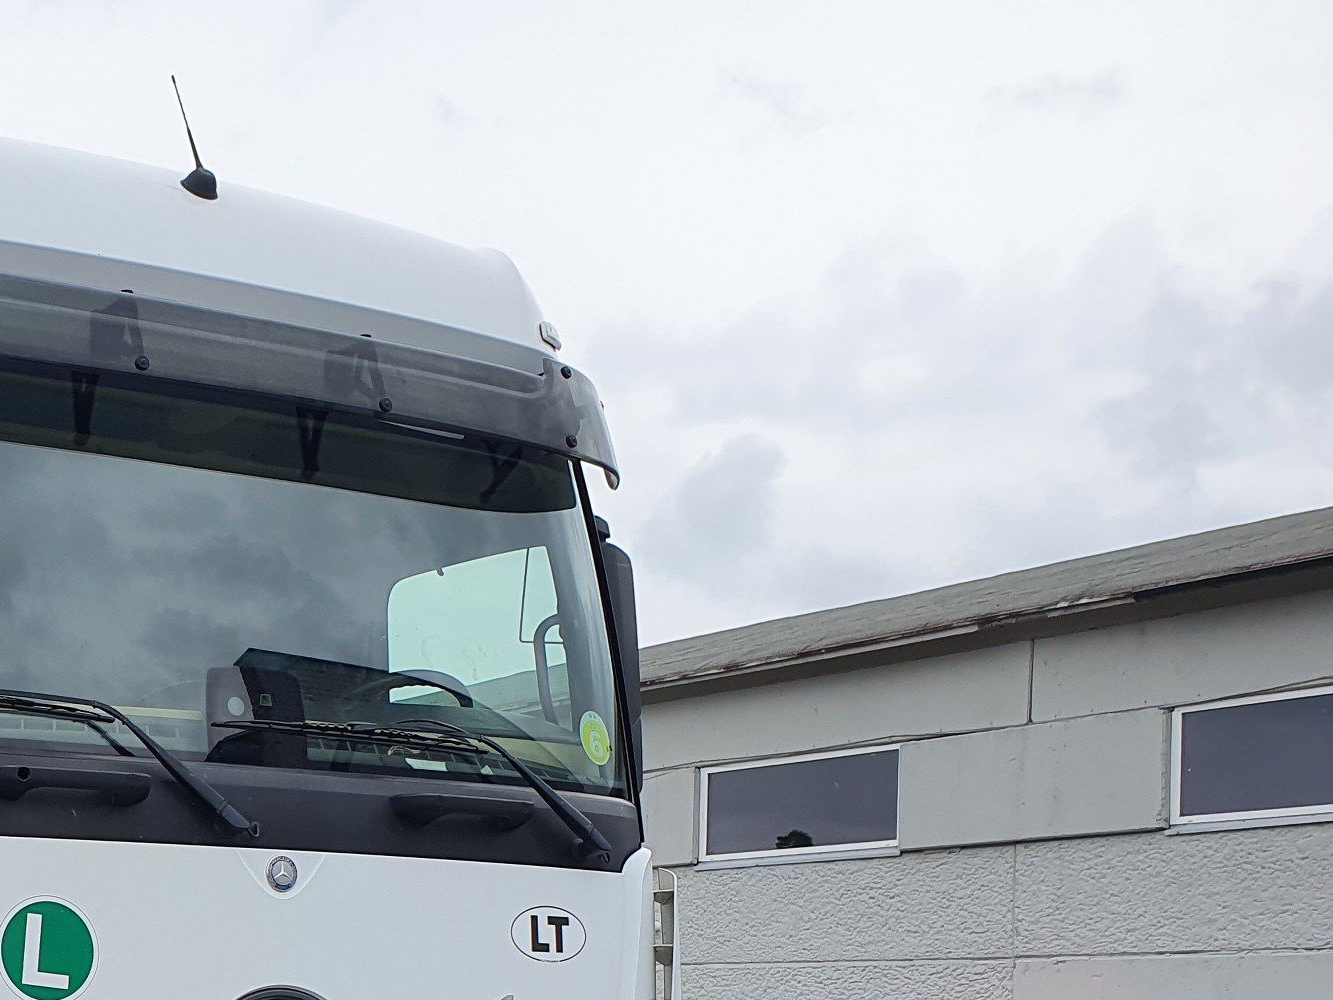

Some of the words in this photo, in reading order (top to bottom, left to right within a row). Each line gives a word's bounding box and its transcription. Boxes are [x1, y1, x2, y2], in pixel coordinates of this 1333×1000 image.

[590, 730, 604, 758] 6
[22, 912, 70, 990] L
[530, 915, 570, 953] LT
